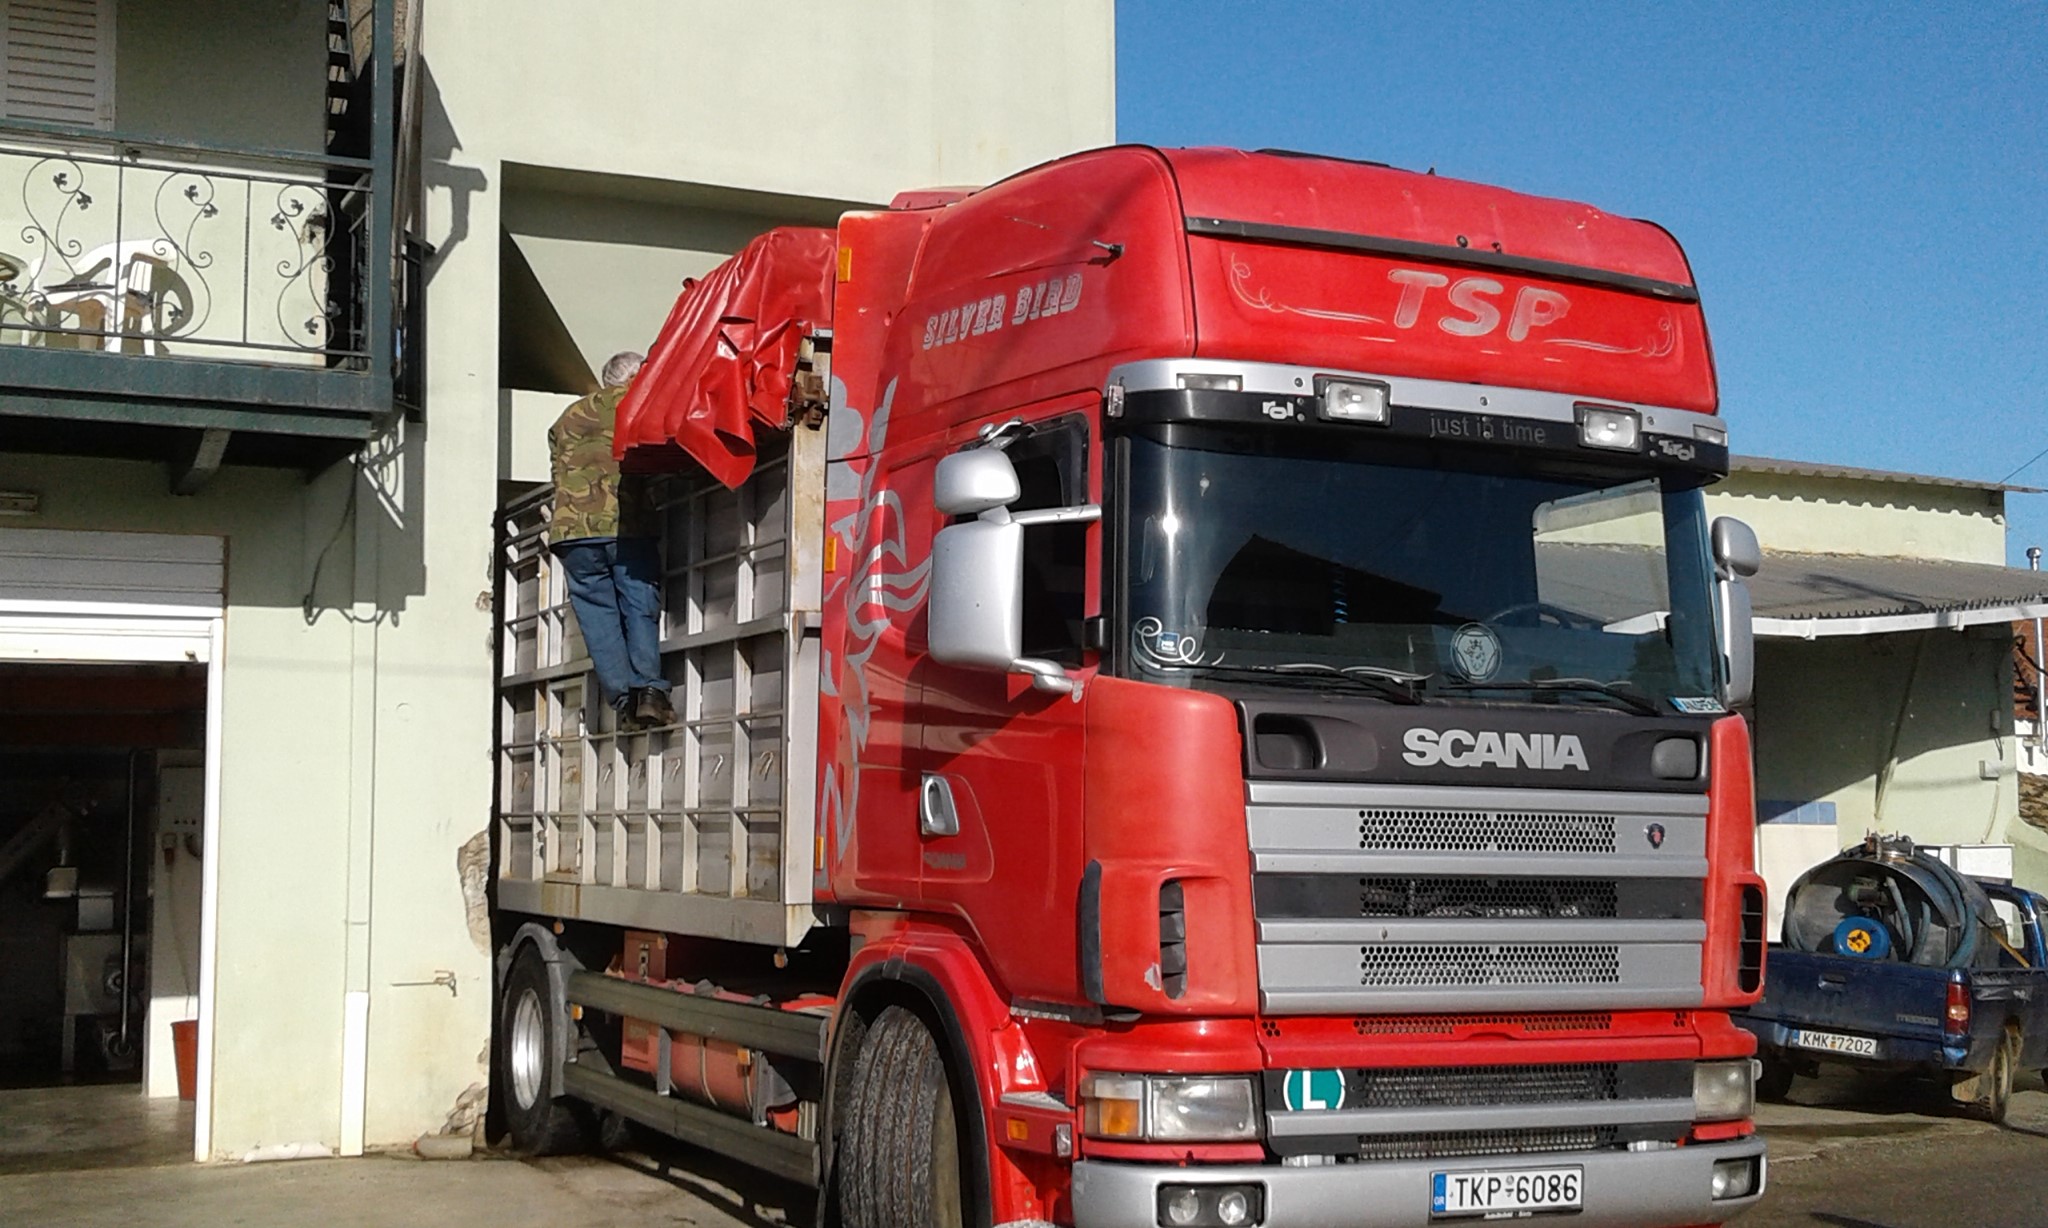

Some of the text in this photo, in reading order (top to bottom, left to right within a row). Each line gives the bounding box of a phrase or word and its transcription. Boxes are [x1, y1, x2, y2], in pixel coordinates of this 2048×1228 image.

[923, 273, 1082, 350] SILVER BIRD
[1388, 268, 1572, 342] TSP
[1430, 412, 1469, 438] just
[1503, 420, 1545, 443] time
[1402, 728, 1590, 771] SCANIA
[1302, 1070, 1327, 1110] L
